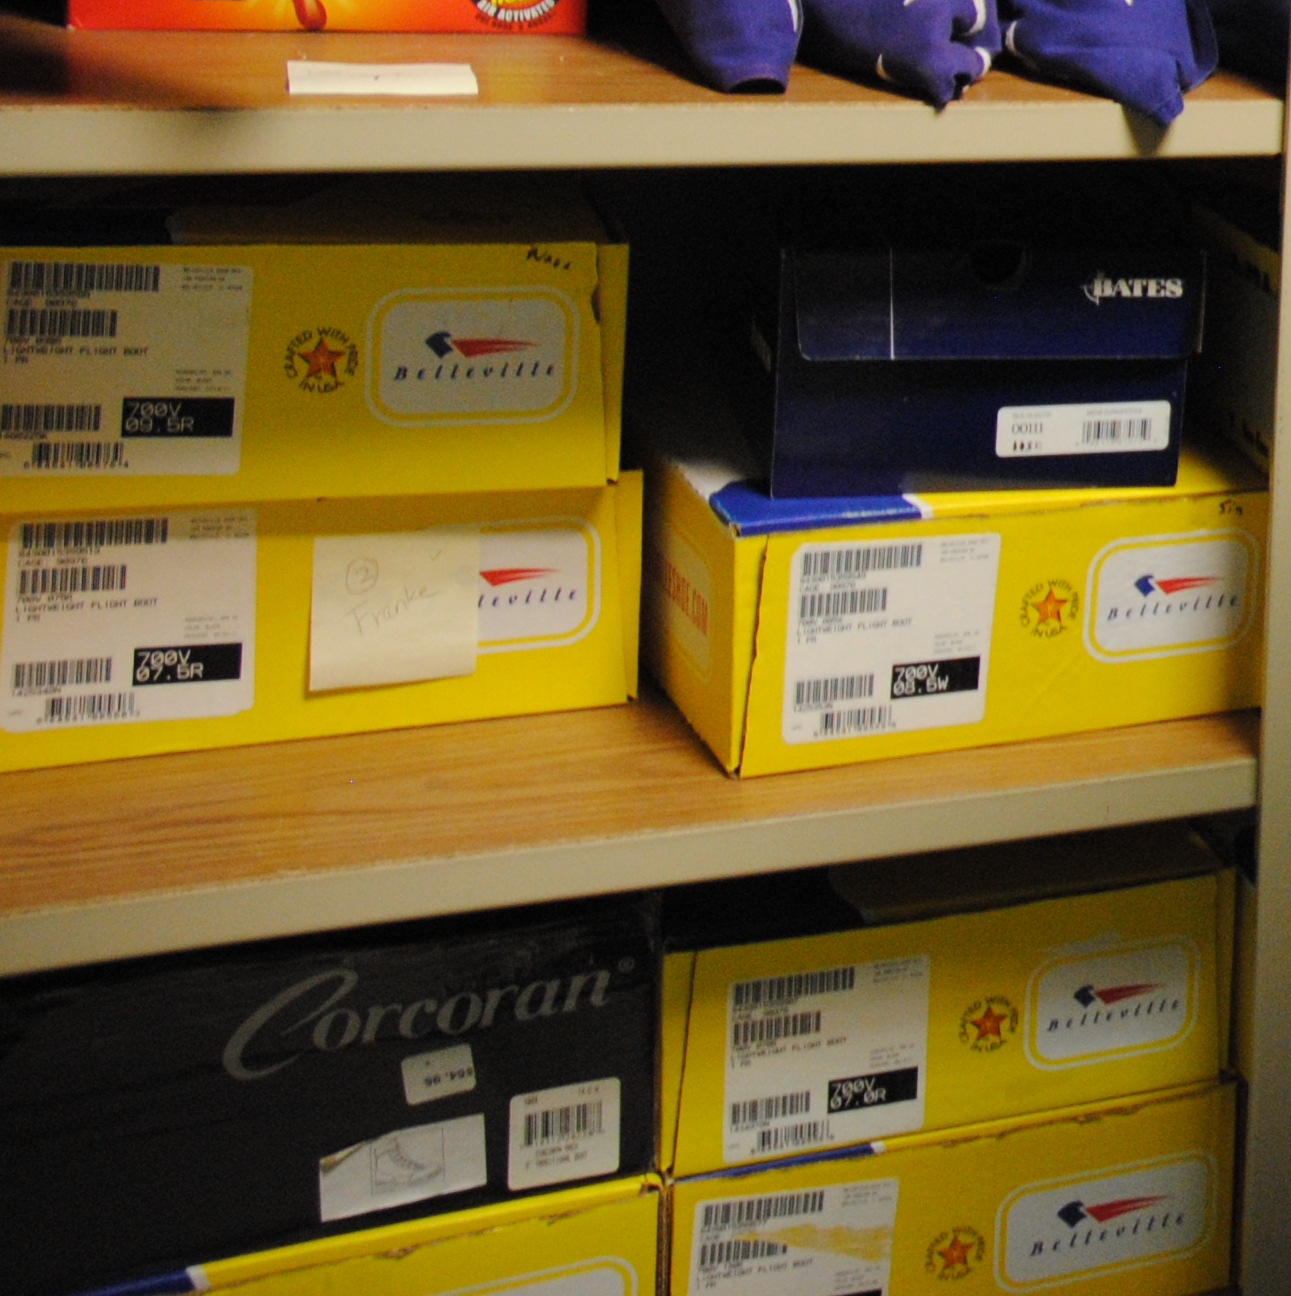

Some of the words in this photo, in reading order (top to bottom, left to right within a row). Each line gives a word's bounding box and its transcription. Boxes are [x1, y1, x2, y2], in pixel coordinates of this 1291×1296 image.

[1092, 278, 1184, 298] BATES
[317, 325, 349, 345] WITH
[393, 359, 555, 381] Belleville
[128, 401, 183, 417] 700V
[125, 417, 195, 433] 09.5R
[15, 599, 85, 614] LIGHTWEIGHT
[91, 598, 127, 610] FLIGHT
[134, 597, 158, 608] BOOT
[1020, 583, 1044, 628] CRAFTED
[1047, 577, 1073, 592] WITH
[1107, 593, 1239, 621] Belleville
[797, 622, 852, 636] LIGHTWEIGHT
[857, 619, 888, 631] FLIGHT
[892, 617, 912, 628] BOOT
[137, 649, 192, 667] 700V
[135, 662, 204, 683] 07.5R
[895, 663, 939, 683] 700V
[893, 676, 949, 697] 08.5W
[222, 968, 612, 1081] Corcoran
[1047, 998, 1180, 1032] Belleville
[831, 1078, 877, 1098] 700V
[830, 1088, 887, 1111] 07.0R
[1030, 1213, 1186, 1257] Belleville
